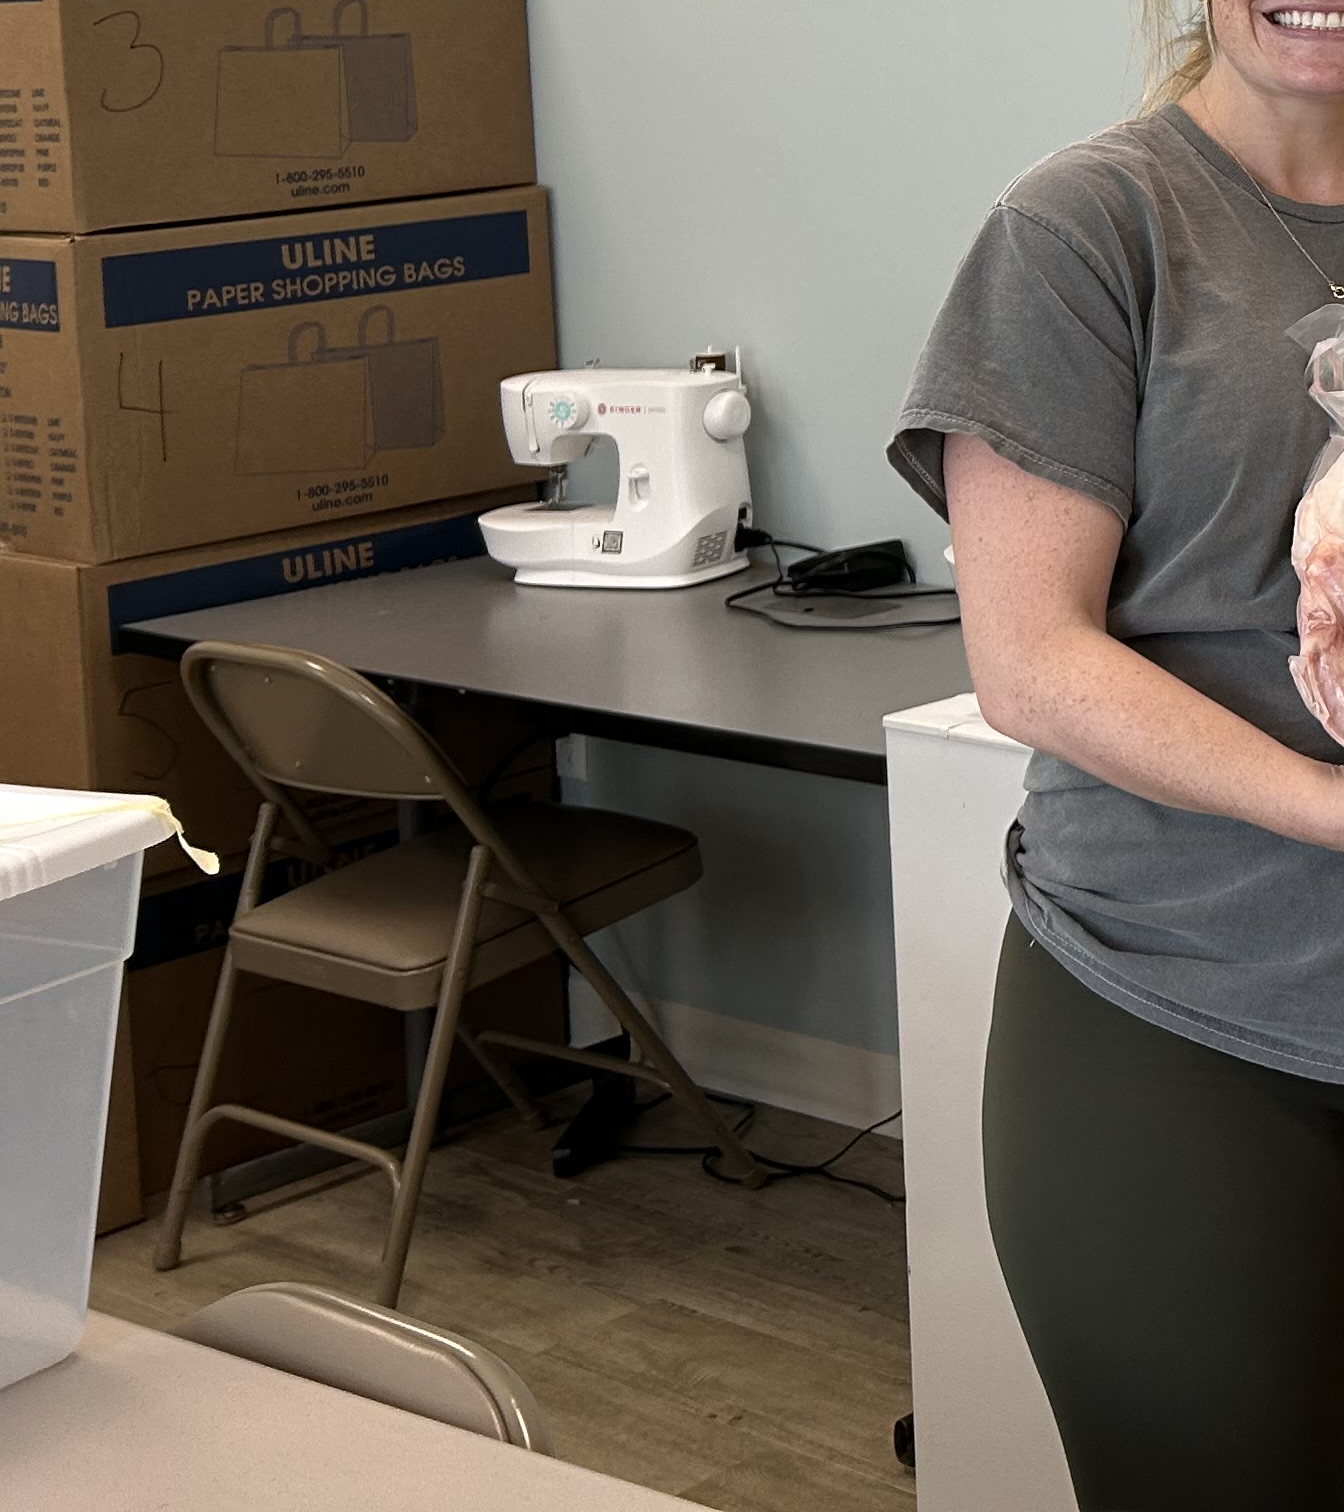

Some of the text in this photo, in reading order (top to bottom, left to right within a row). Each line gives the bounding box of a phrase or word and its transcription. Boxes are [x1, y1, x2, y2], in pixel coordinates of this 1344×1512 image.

[93, 9, 165, 113] 3
[291, 183, 350, 198] uline.com
[281, 234, 376, 270] ULINE
[187, 256, 465, 311] PAPER SHOPPING BAGS
[22, 302, 58, 325] BAGS
[118, 352, 179, 463] 4
[312, 492, 373, 512] uline.com
[282, 541, 375, 584] ULINE
